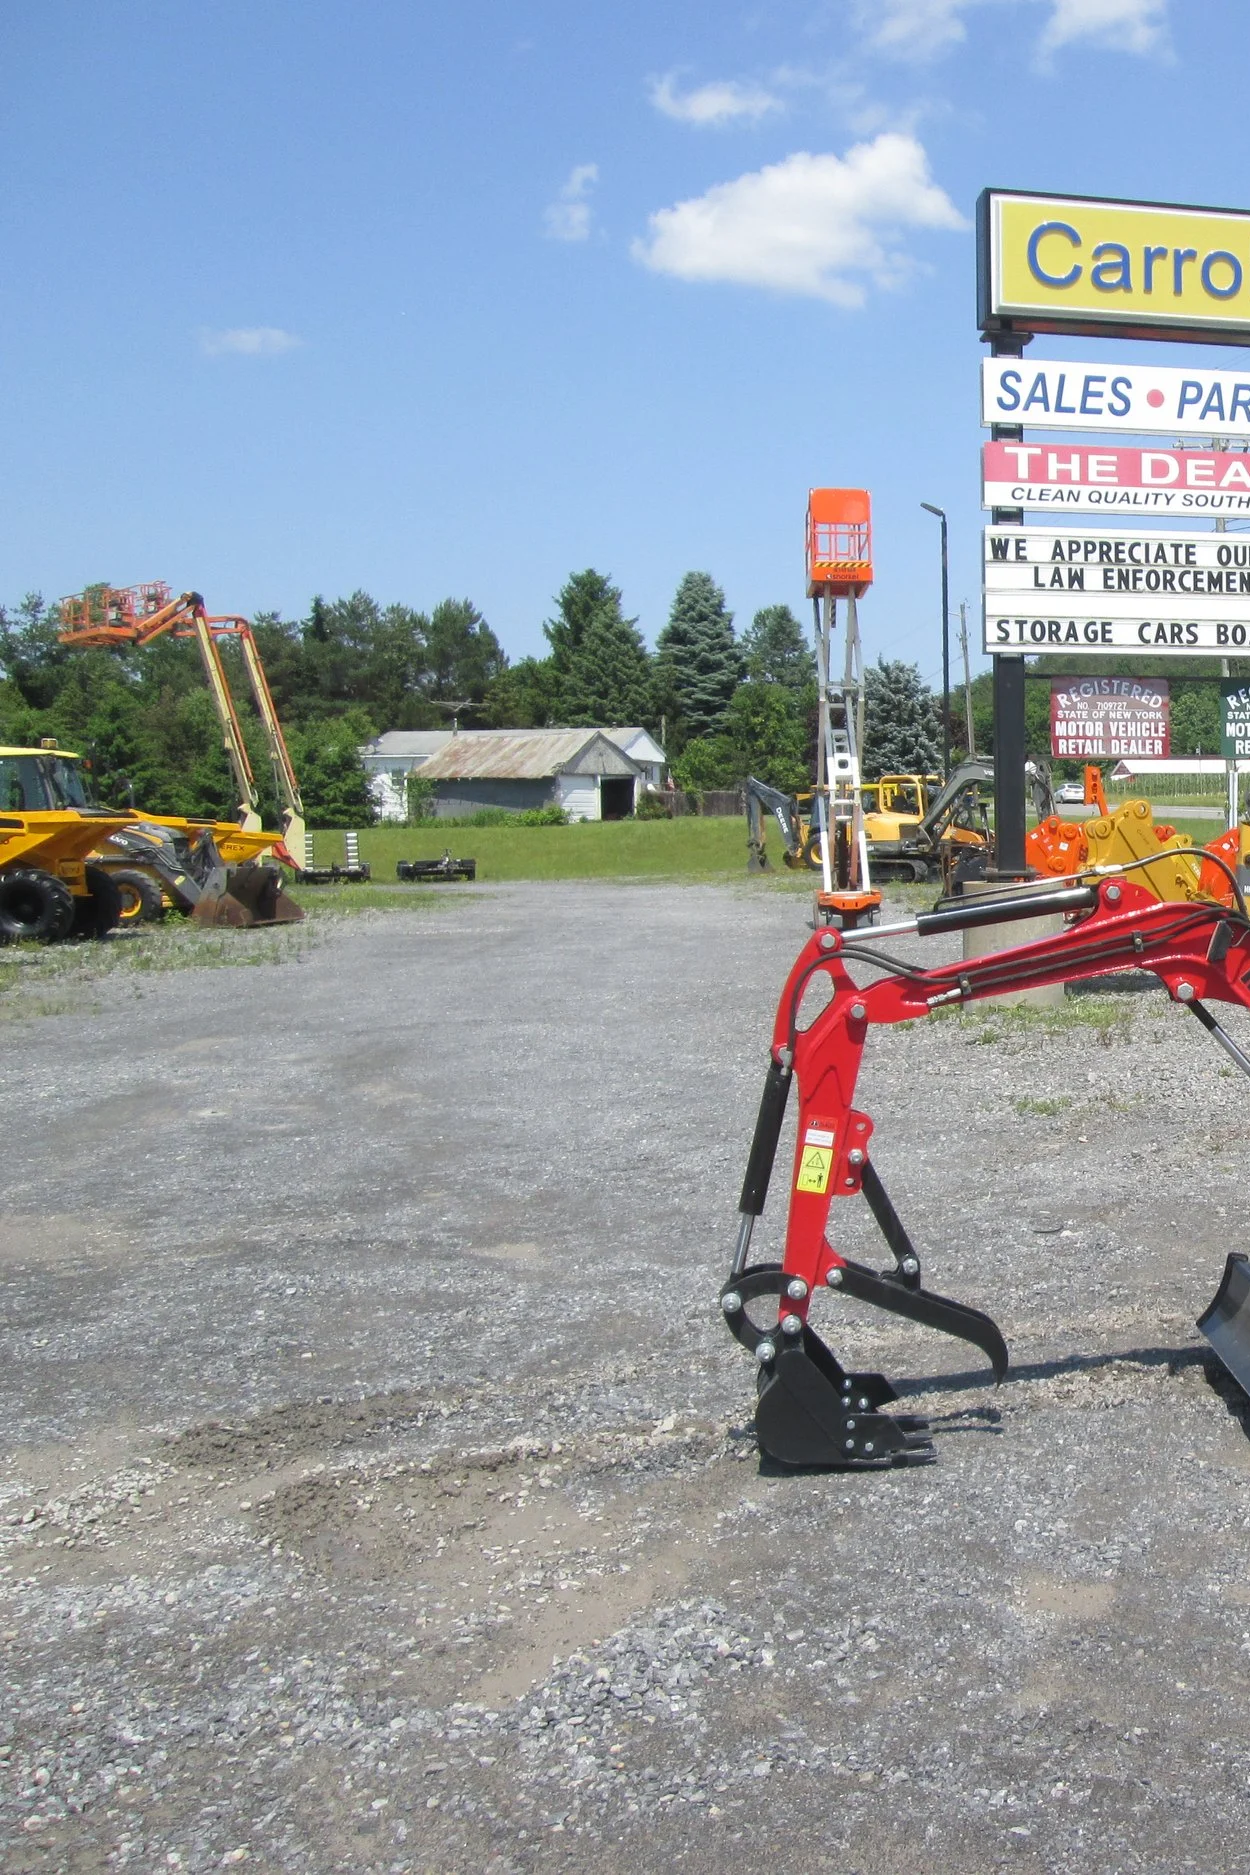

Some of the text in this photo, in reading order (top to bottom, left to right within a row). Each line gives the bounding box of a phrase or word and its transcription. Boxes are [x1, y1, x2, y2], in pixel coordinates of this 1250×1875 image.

[996, 370, 1132, 416] SALES
[1004, 446, 1119, 482] THE
[1011, 487, 1080, 503] CLEAN
[1088, 490, 1176, 506] QUALITY
[991, 538, 1028, 561] WE
[1051, 540, 1197, 565] APPRECIATE
[1034, 566, 1085, 590] LAW
[997, 620, 1113, 643] STORAGE
[1138, 622, 1199, 645] CARS
[1057, 680, 1162, 708] REGISTERED
[1096, 702, 1127, 710] 7109727
[1057, 710, 1162, 719] STATE OF NEW YORK
[1055, 721, 1166, 737] MOTOR VEHICLE
[1059, 739, 1162, 754] RETAIL DEALER
[776, 806, 789, 834] DEERE
